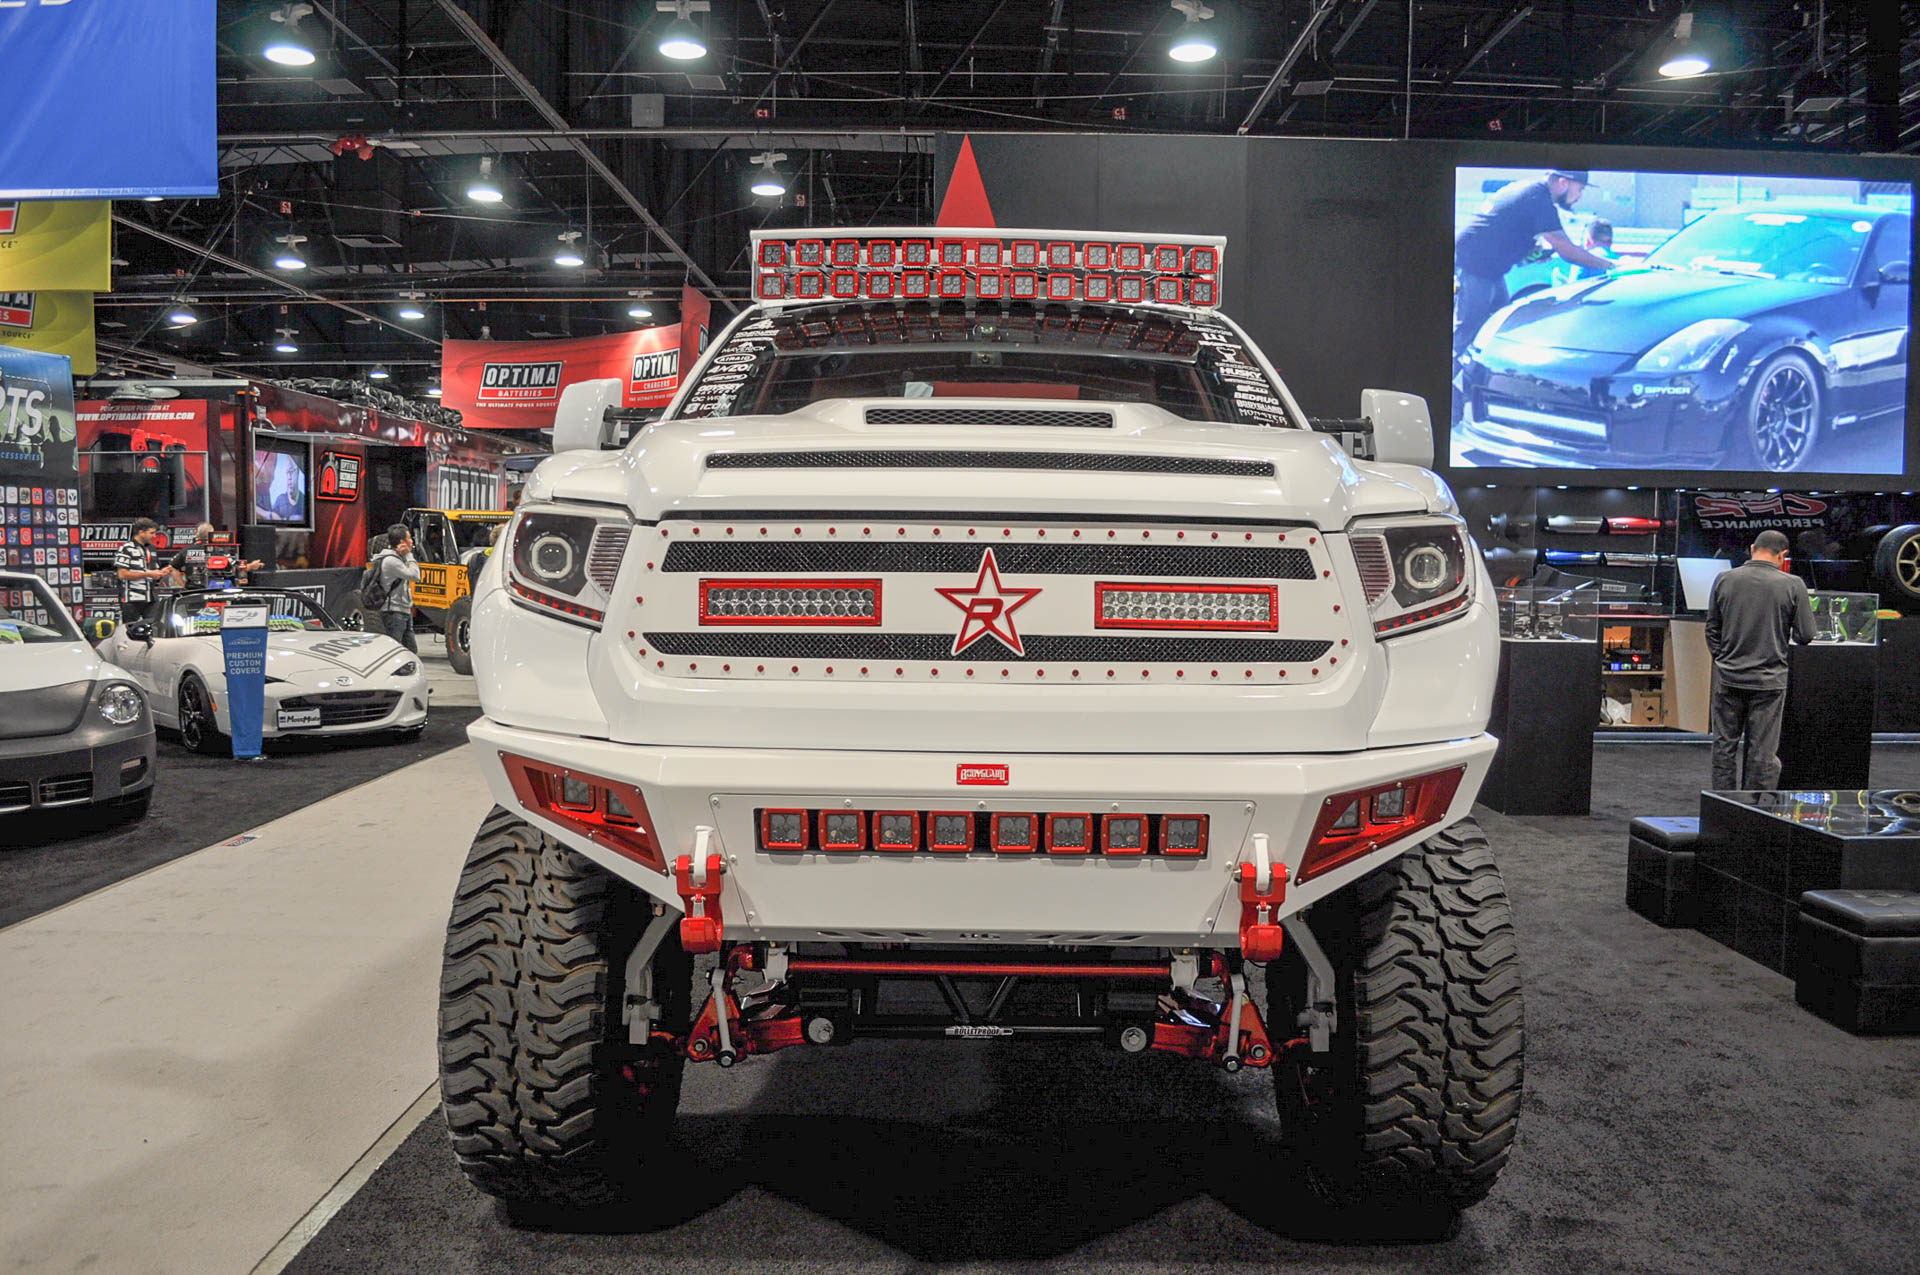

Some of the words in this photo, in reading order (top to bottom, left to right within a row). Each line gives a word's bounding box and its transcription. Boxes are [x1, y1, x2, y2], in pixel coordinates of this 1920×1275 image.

[634, 353, 678, 379] OPTIMA
[485, 366, 557, 386] OPTIMA
[643, 379, 671, 390] CHARGERS
[1644, 386, 1690, 395] SPYDER
[699, 402, 732, 411] ICON
[76, 412, 196, 421] WWW.OPTIMABATTERIES.COM
[226, 652, 264, 660] PREMIUM
[230, 667, 261, 675] COVERS
[953, 1027, 1001, 1036] BULLETPROOF
